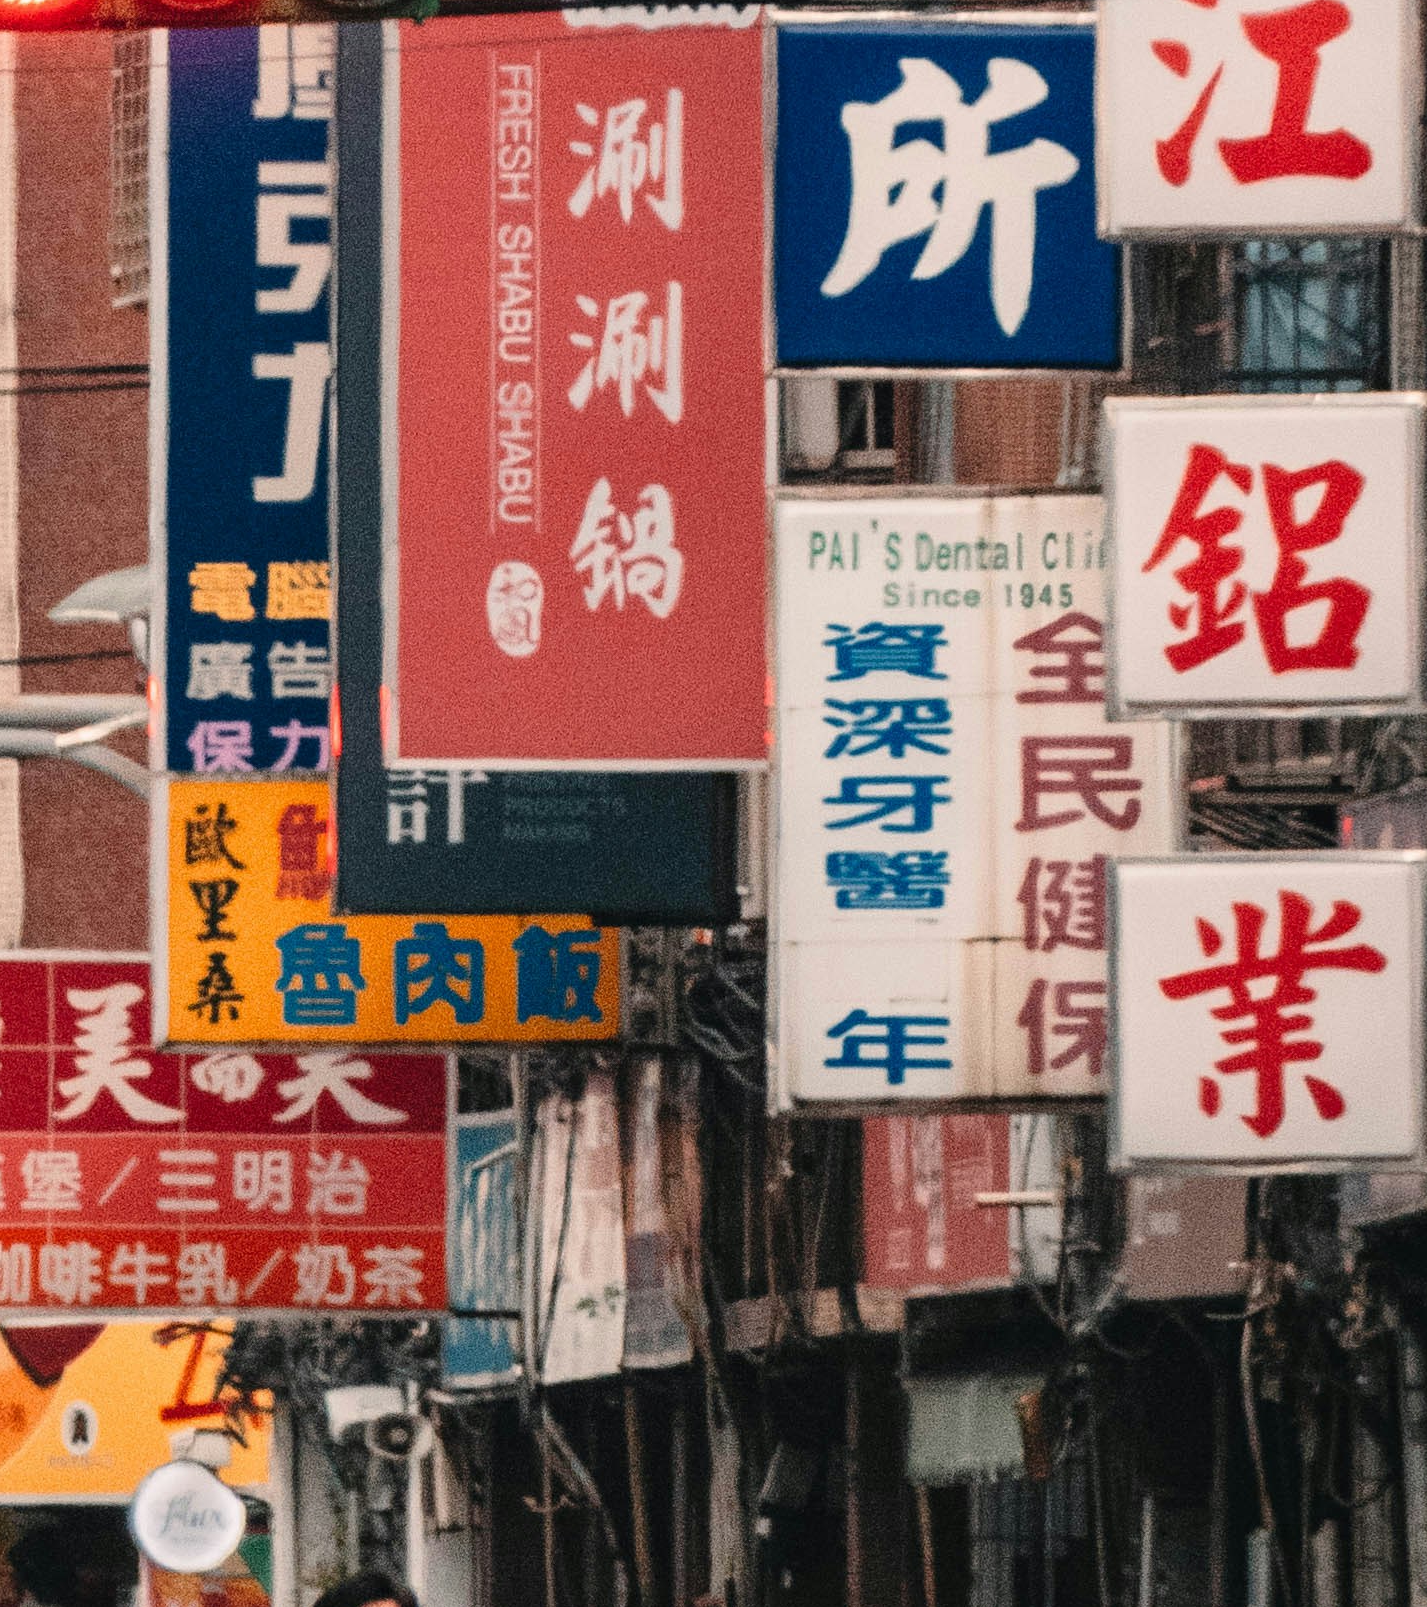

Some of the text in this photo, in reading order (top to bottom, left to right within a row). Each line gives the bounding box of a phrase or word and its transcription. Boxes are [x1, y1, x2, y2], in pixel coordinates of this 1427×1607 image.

[498, 64, 533, 202] FRESH
[498, 224, 533, 363] SHABU
[568, 88, 684, 618] 涮涮鍋
[498, 382, 533, 524] SHABU
[884, 582, 1073, 610] Since 1945
[916, 533, 1023, 571] Dental
[186, 641, 329, 701] 廣告
[185, 803, 245, 1024] 歐里桑
[824, 622, 952, 1085] 資深牙醫 年
[1013, 612, 1144, 1076] 全民健保
[275, 922, 603, 1025] 魯肉飯
